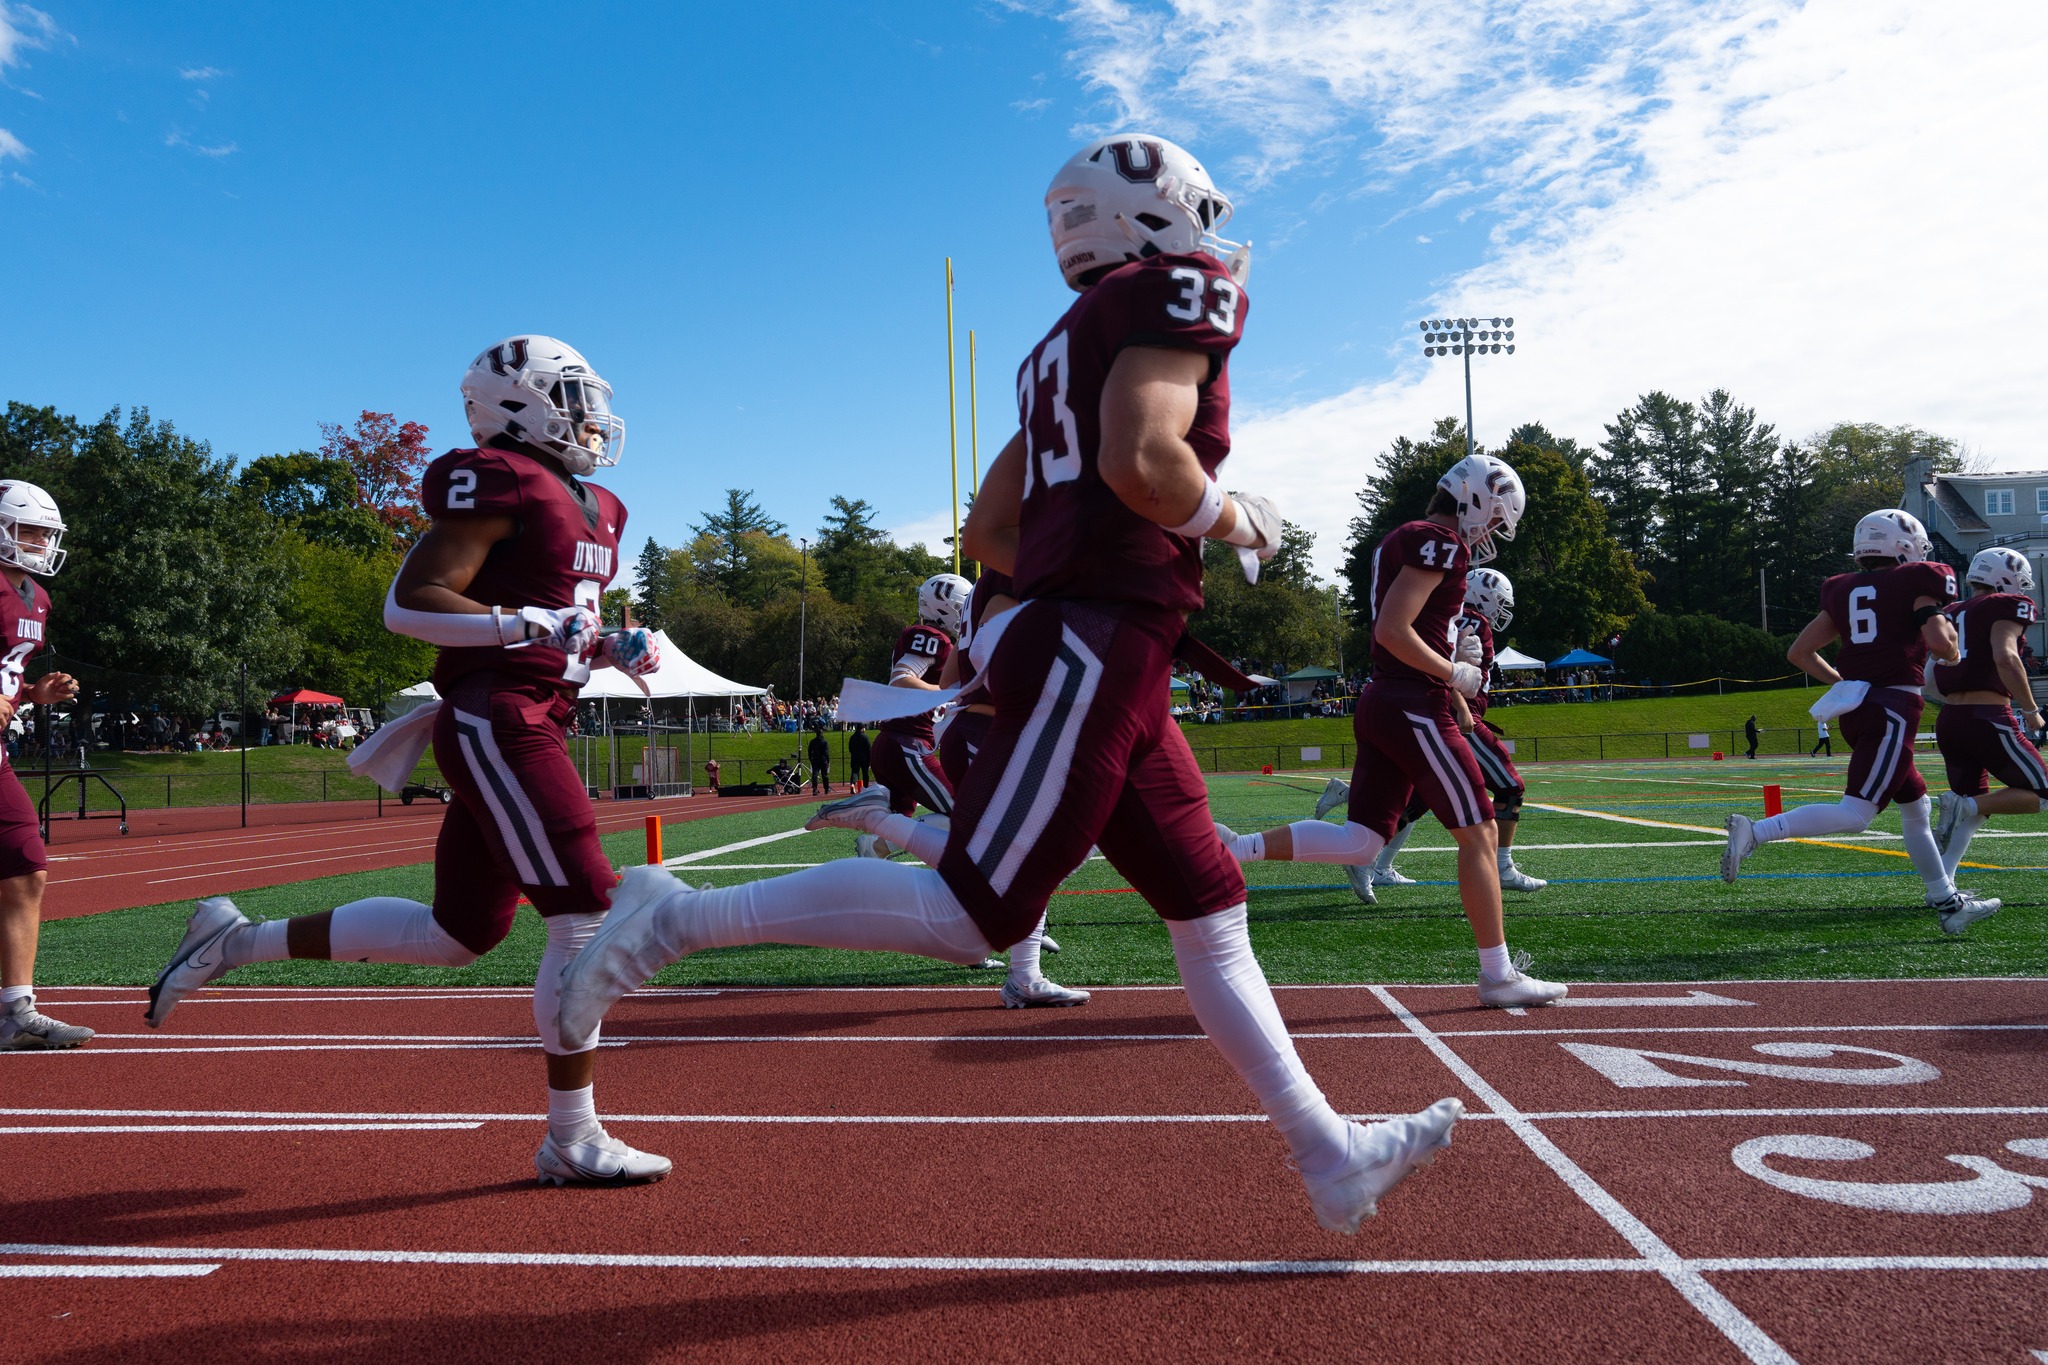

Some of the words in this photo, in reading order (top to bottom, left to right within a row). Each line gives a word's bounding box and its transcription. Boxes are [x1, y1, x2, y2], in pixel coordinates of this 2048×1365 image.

[1107, 140, 1164, 184] U
[1062, 251, 1096, 269] CANNON
[1165, 266, 1239, 337] 33
[487, 338, 529, 377] U
[447, 469, 477, 509] 2
[1484, 468, 1518, 497] U
[572, 541, 613, 577] UNION
[1419, 539, 1459, 570] 47
[1945, 574, 1956, 596] 6
[1848, 585, 1878, 645] 6
[2016, 602, 2036, 622] 21
[17, 618, 43, 641] UNION
[911, 633, 940, 656] 20
[1557, 1042, 1941, 1088] 2
